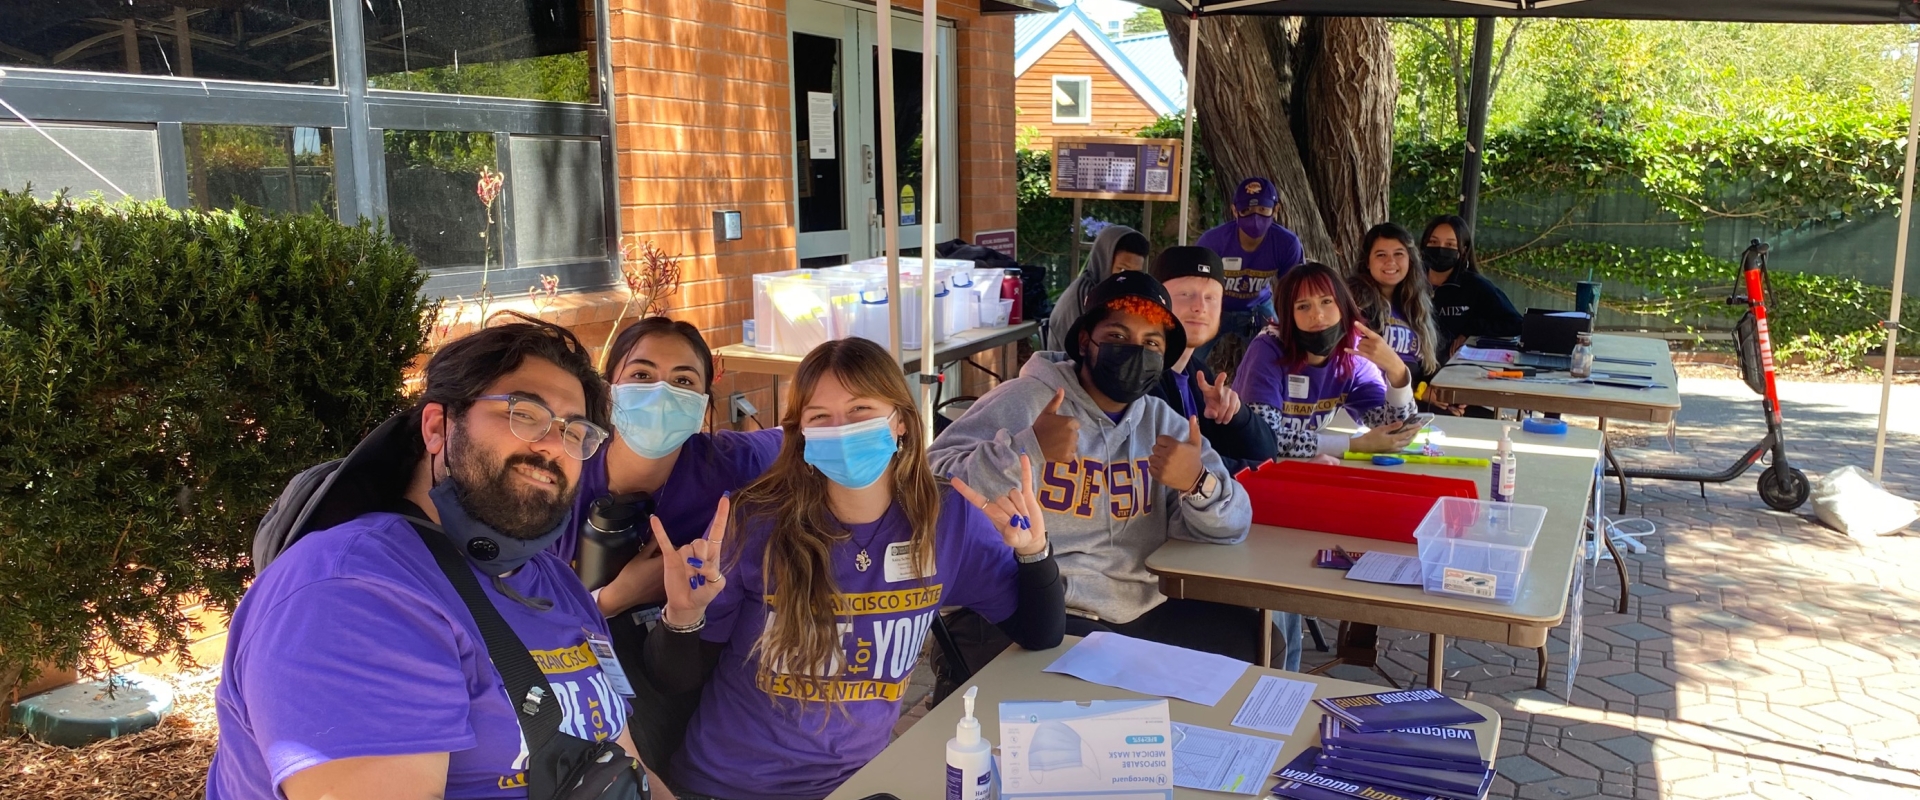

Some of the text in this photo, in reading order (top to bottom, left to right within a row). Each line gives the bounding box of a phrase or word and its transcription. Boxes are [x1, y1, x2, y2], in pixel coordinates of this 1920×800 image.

[1116, 509, 1131, 517] STAT
[829, 586, 942, 612] ANCISCO STATE
[848, 638, 872, 674] for
[757, 675, 889, 699] ESDENTIAL
[1376, 688, 1444, 704] welcome
[1333, 695, 1384, 710] home!
[587, 697, 608, 741] for
[1108, 750, 1166, 759] MEDICAL MASK
[1112, 775, 1155, 784] Norcoguard
[1280, 768, 1410, 800] welcome hom
